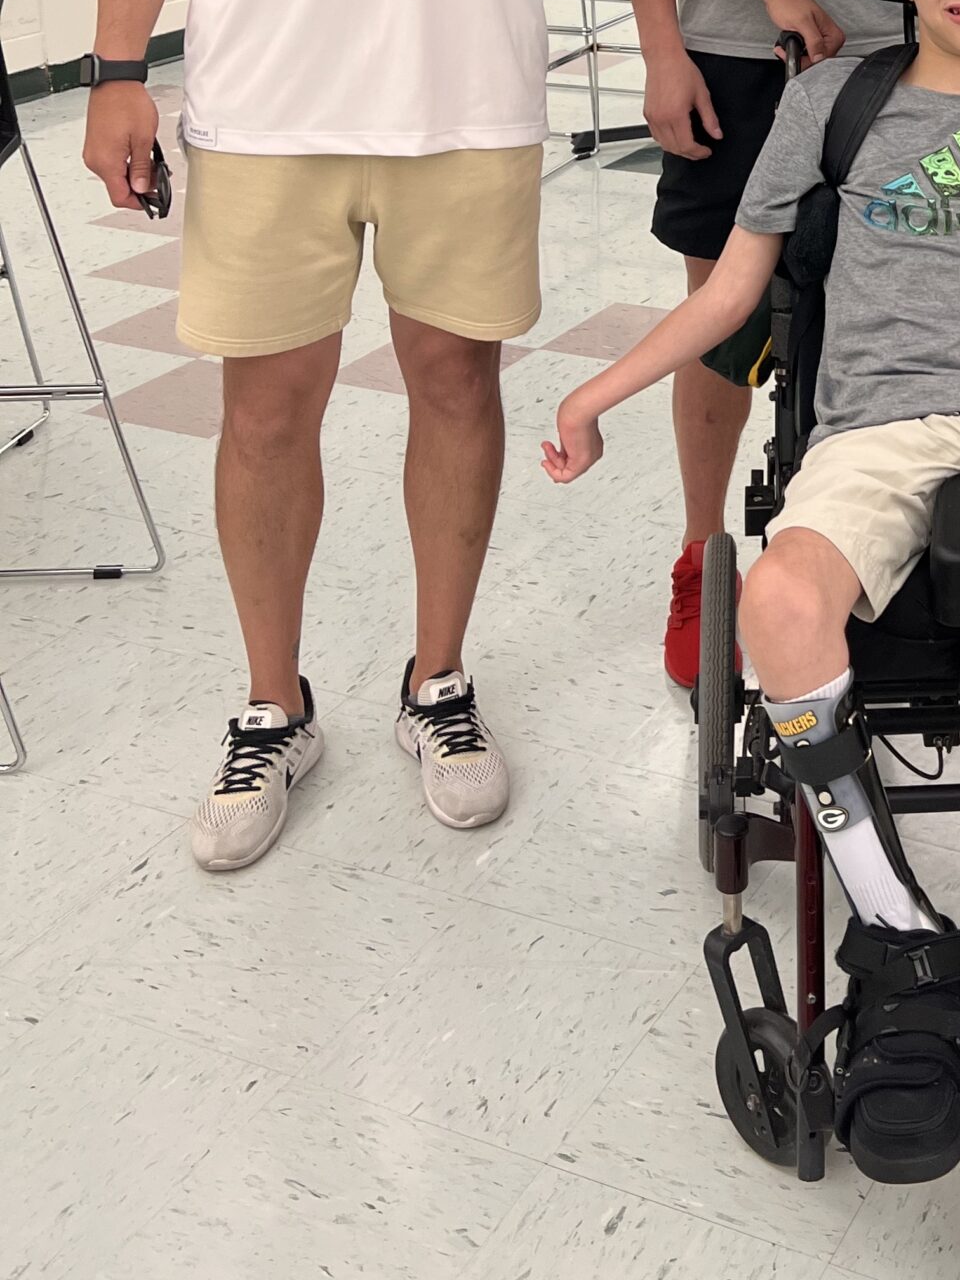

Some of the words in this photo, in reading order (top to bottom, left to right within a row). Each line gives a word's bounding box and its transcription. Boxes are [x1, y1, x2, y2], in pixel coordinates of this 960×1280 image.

[438, 683, 456, 699] NIKE
[246, 715, 265, 726] NIKE
[774, 710, 817, 737] ACKERS
